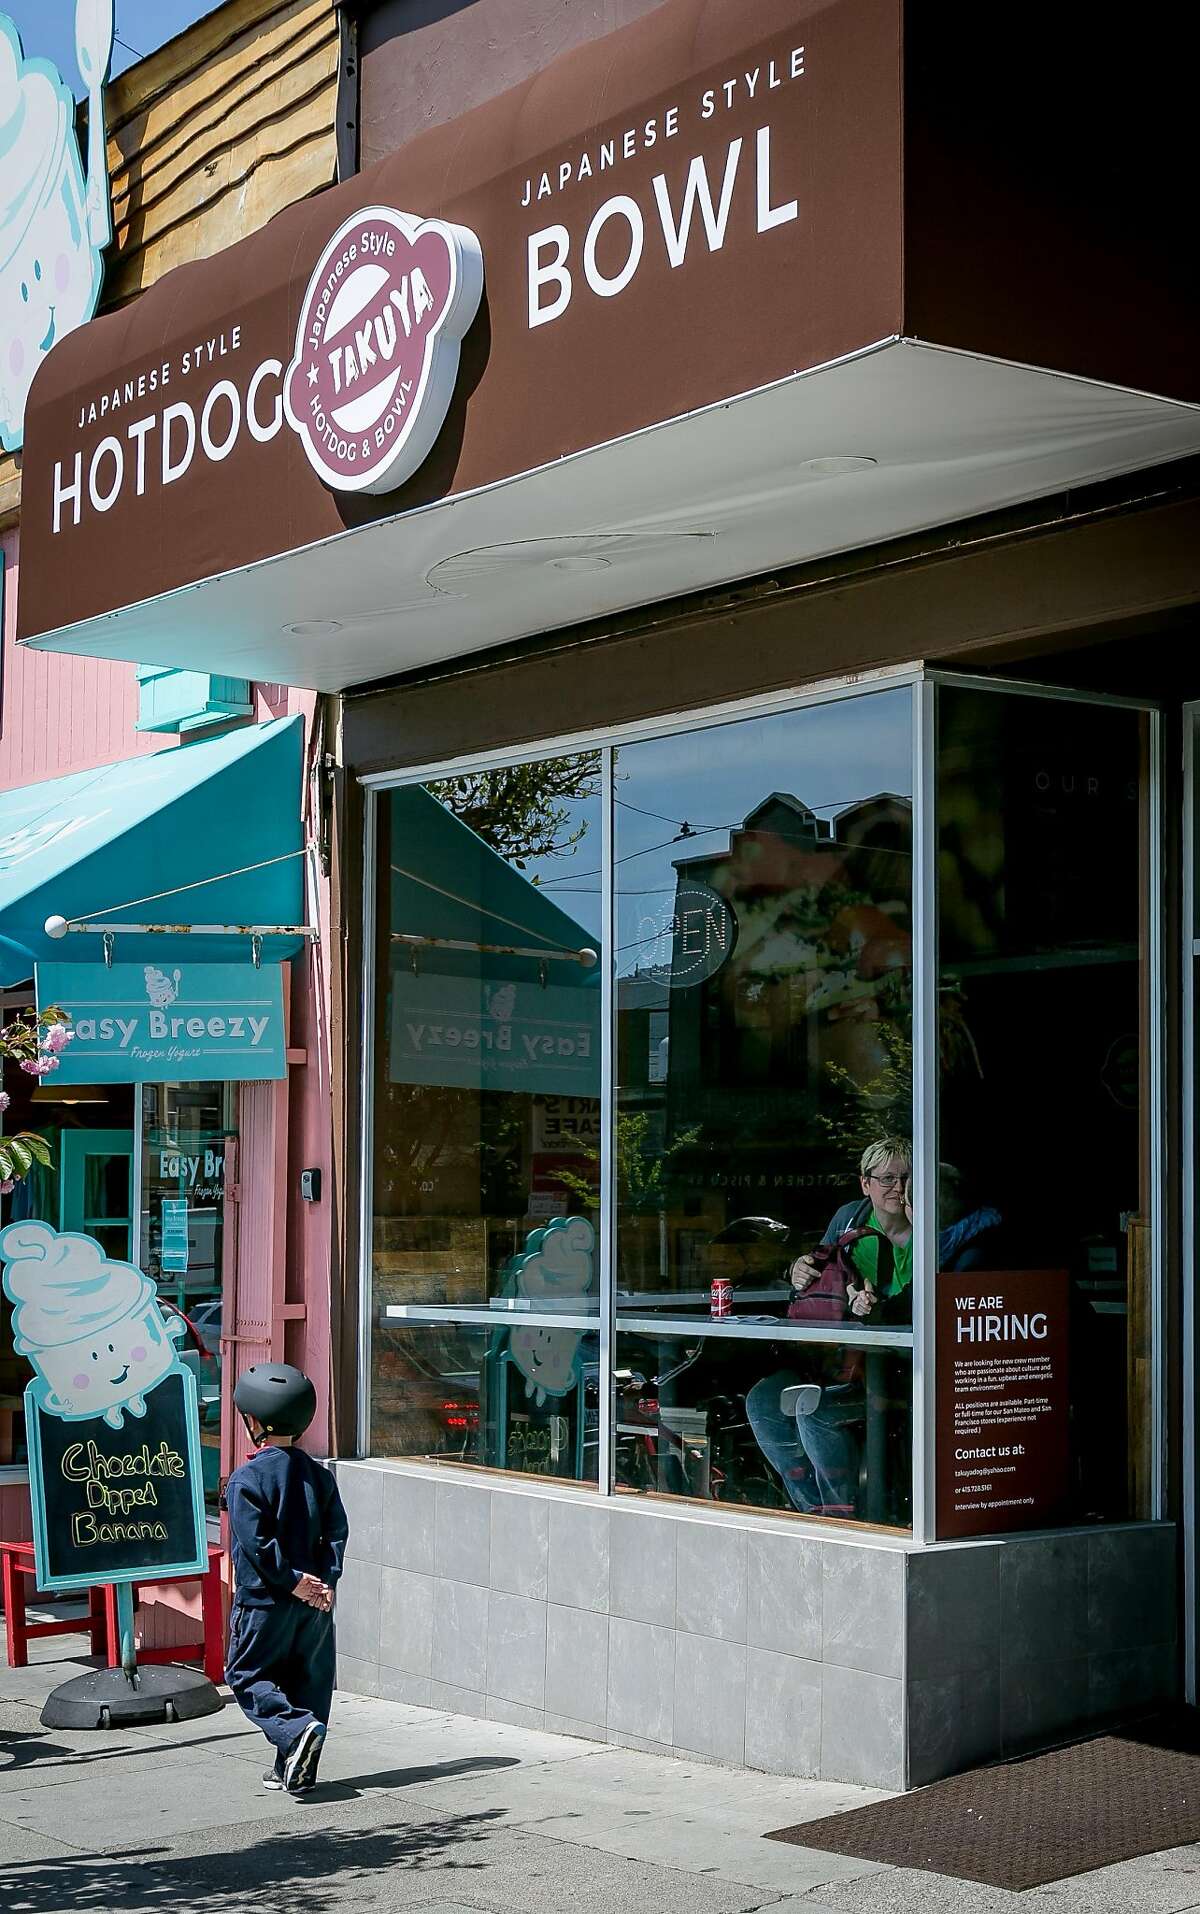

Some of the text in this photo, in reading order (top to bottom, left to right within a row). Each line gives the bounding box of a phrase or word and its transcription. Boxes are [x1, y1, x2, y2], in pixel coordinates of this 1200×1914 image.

[520, 47, 804, 207] JAPANESE STYLE
[528, 126, 798, 329] BOWL
[309, 230, 395, 351] Japanese Style
[328, 266, 434, 395] TAKUYA
[78, 325, 240, 428] JAPANESE STYLE
[310, 379, 412, 461] HOTDOG & BOWL
[53, 358, 283, 533] HOTDOG
[150, 1010, 269, 1046] Breezy
[131, 1045, 201, 1062] Frozen Yogurt
[160, 1150, 225, 1186] Easy Br
[955, 1296, 1003, 1310] WE ARE
[957, 1313, 1047, 1342] HIRING
[974, 1359, 993, 1367] looking
[977, 1367, 1004, 1375] passionate
[955, 1418, 979, 1426] Francisco
[966, 1401, 989, 1410] positions
[61, 1440, 185, 1481] Chocolate
[955, 1444, 1025, 1459] Contact us at:
[87, 1480, 157, 1515] Dipped
[955, 1502, 980, 1511] Interview
[981, 1501, 987, 1509] by
[988, 1498, 1022, 1508] appointment
[72, 1512, 168, 1547] Banana
